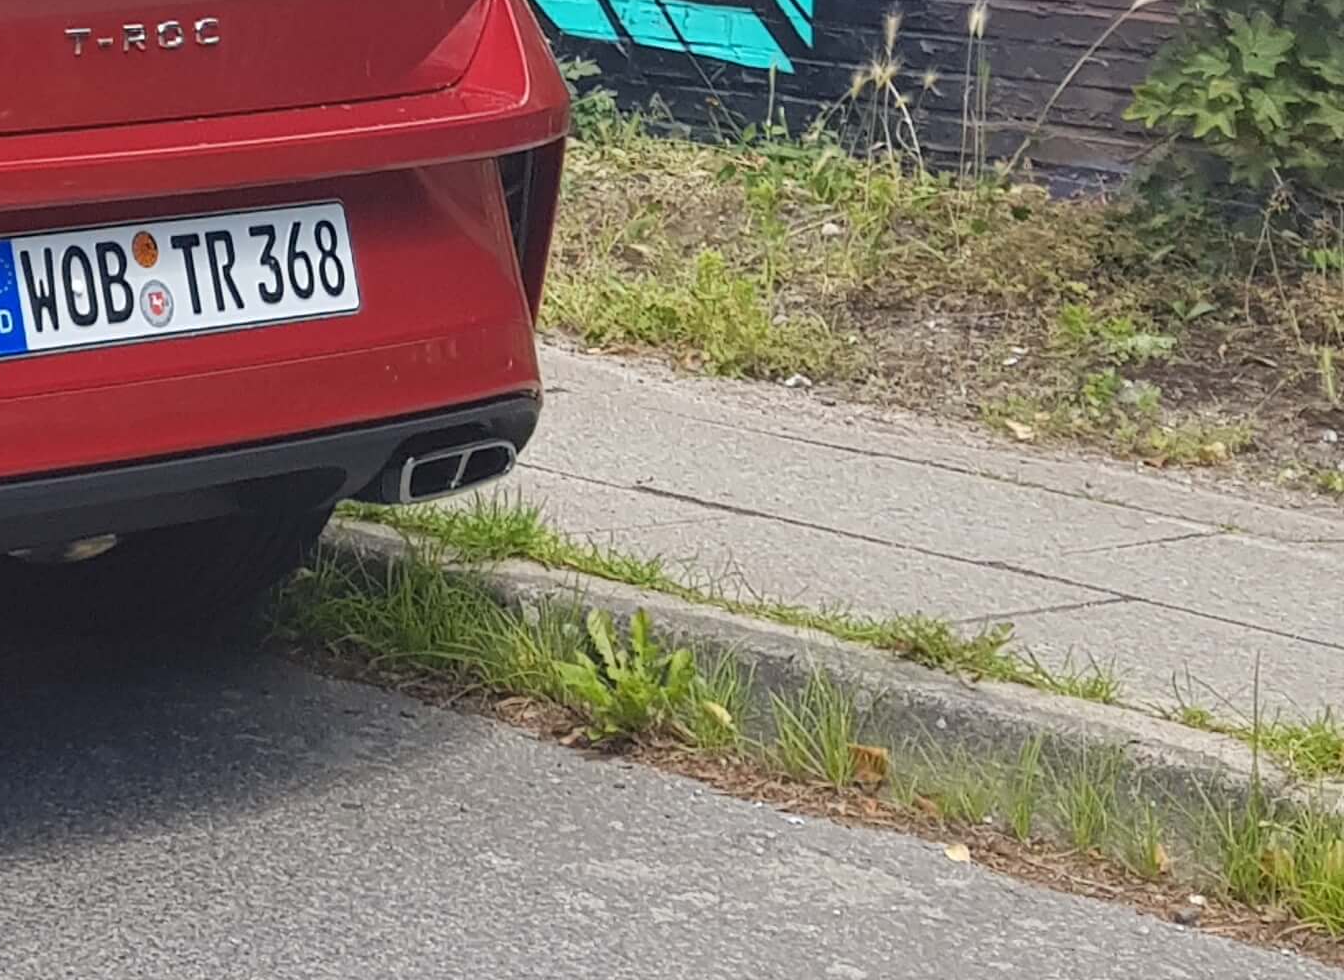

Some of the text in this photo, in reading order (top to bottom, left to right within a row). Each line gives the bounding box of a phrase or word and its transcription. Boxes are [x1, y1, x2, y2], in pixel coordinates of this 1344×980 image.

[63, 17, 221, 57] T-ROC
[20, 219, 345, 333] WOB TR 368
